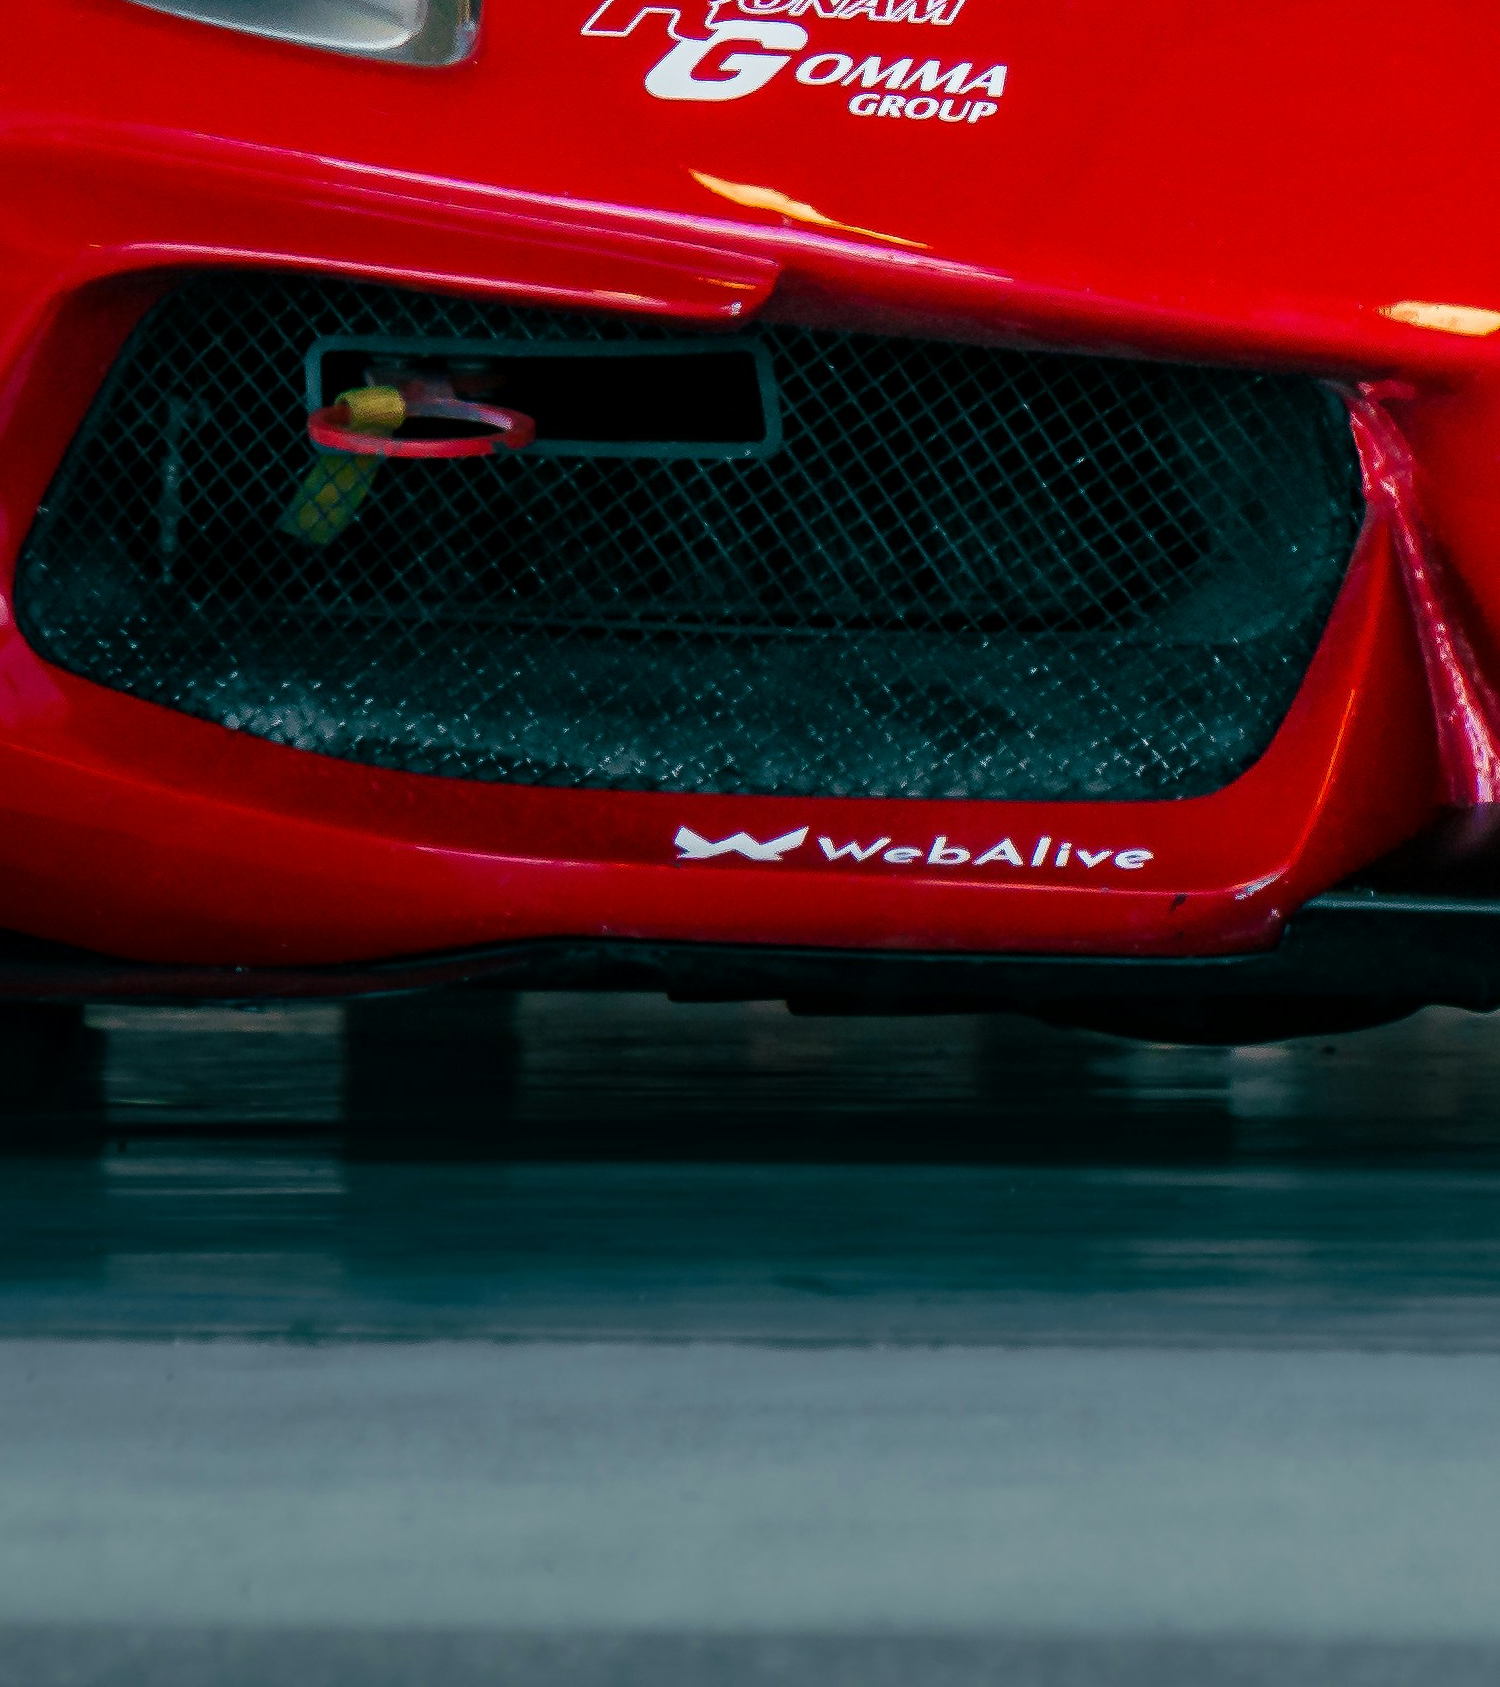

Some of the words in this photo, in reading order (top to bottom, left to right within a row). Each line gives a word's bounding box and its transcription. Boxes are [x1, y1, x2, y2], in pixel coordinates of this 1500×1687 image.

[643, 19, 1009, 103] GOMMA
[847, 93, 999, 124] GROUP
[816, 834, 1156, 871] WebAlive
